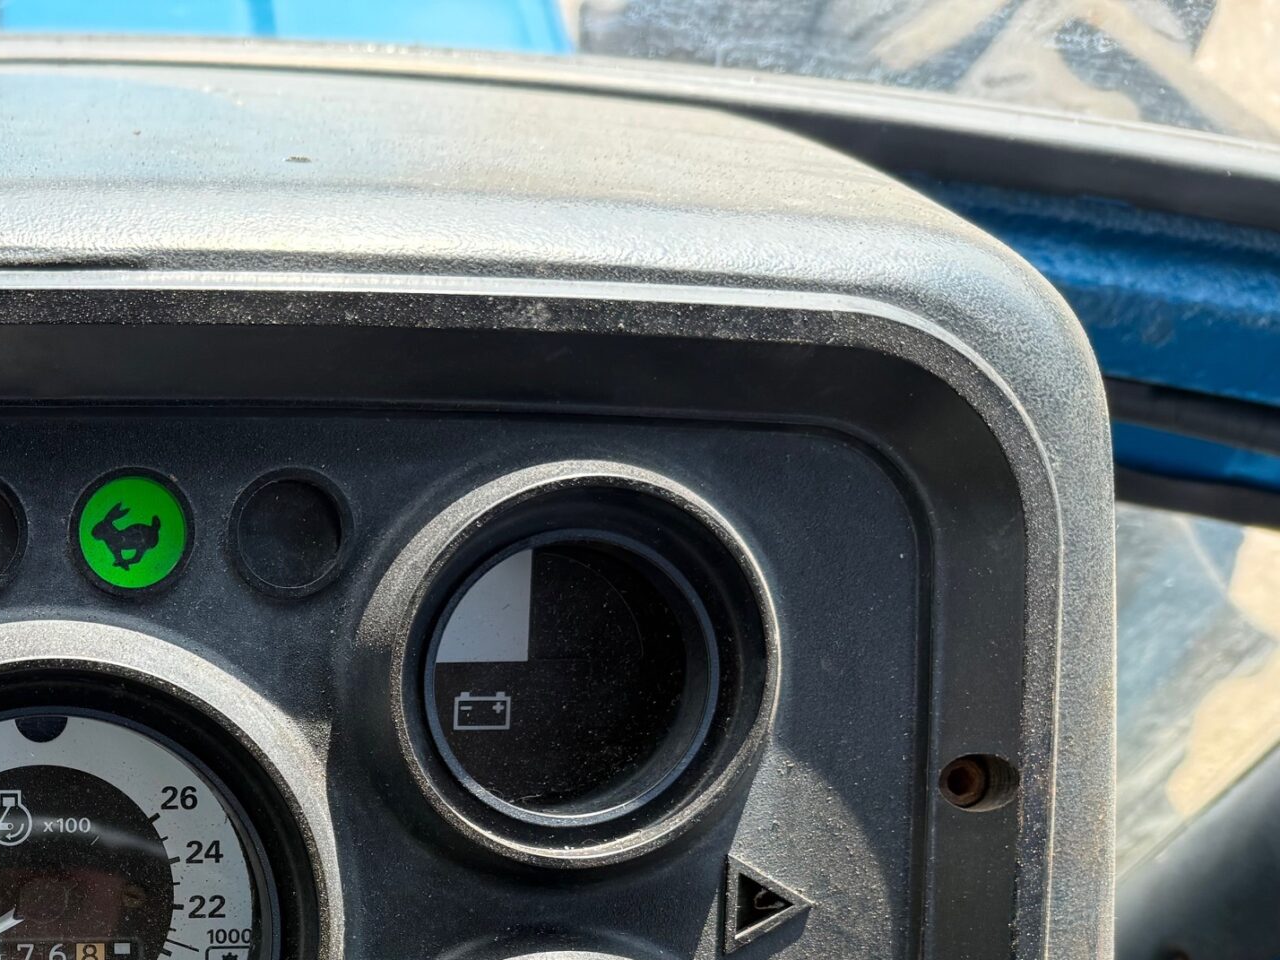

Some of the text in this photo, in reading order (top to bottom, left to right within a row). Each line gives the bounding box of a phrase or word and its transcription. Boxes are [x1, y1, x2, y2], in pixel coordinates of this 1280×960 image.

[160, 785, 198, 810] 26
[43, 817, 91, 834] x100
[185, 840, 224, 864] 24
[188, 894, 226, 919] 22
[206, 928, 252, 944] 1000
